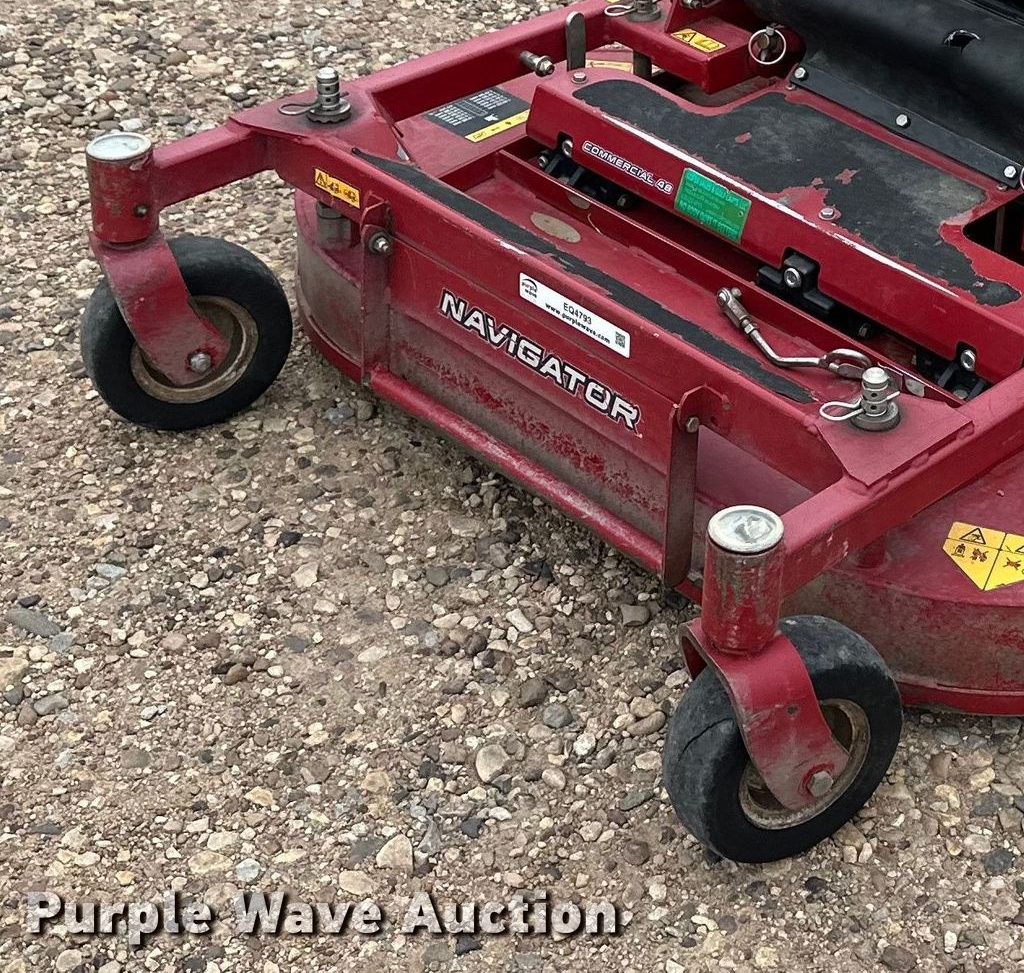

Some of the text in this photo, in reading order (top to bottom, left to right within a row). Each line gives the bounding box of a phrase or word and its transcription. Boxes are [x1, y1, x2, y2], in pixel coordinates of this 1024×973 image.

[583, 141, 674, 194] COMMERCIAL 48
[563, 302, 593, 325] EQ4793
[440, 289, 641, 431] NAVIGATOR
